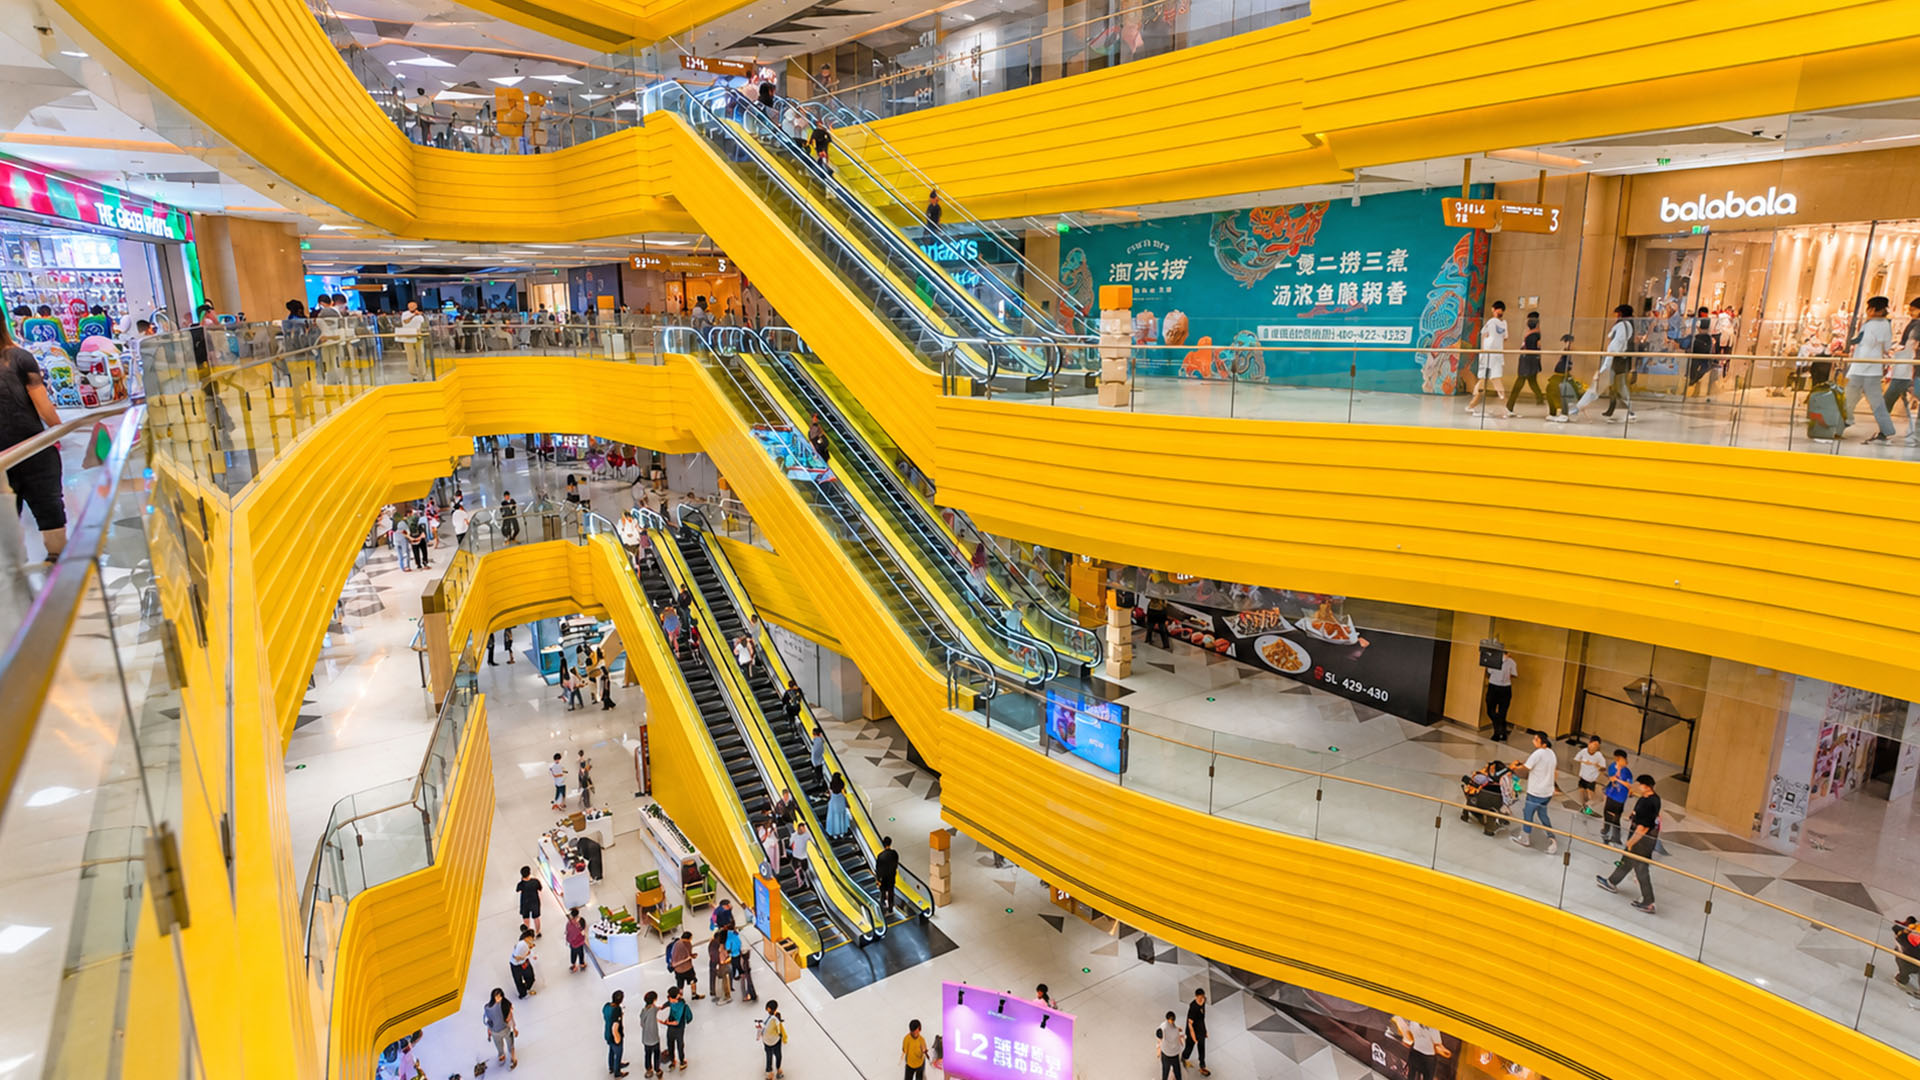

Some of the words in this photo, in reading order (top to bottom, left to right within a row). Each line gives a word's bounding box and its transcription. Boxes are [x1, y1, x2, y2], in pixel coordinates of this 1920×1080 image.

[1660, 186, 1797, 223] balabala
[1549, 208, 1560, 232] 3
[1342, 678, 1389, 702] 429-430
[954, 1029, 990, 1061] L2
